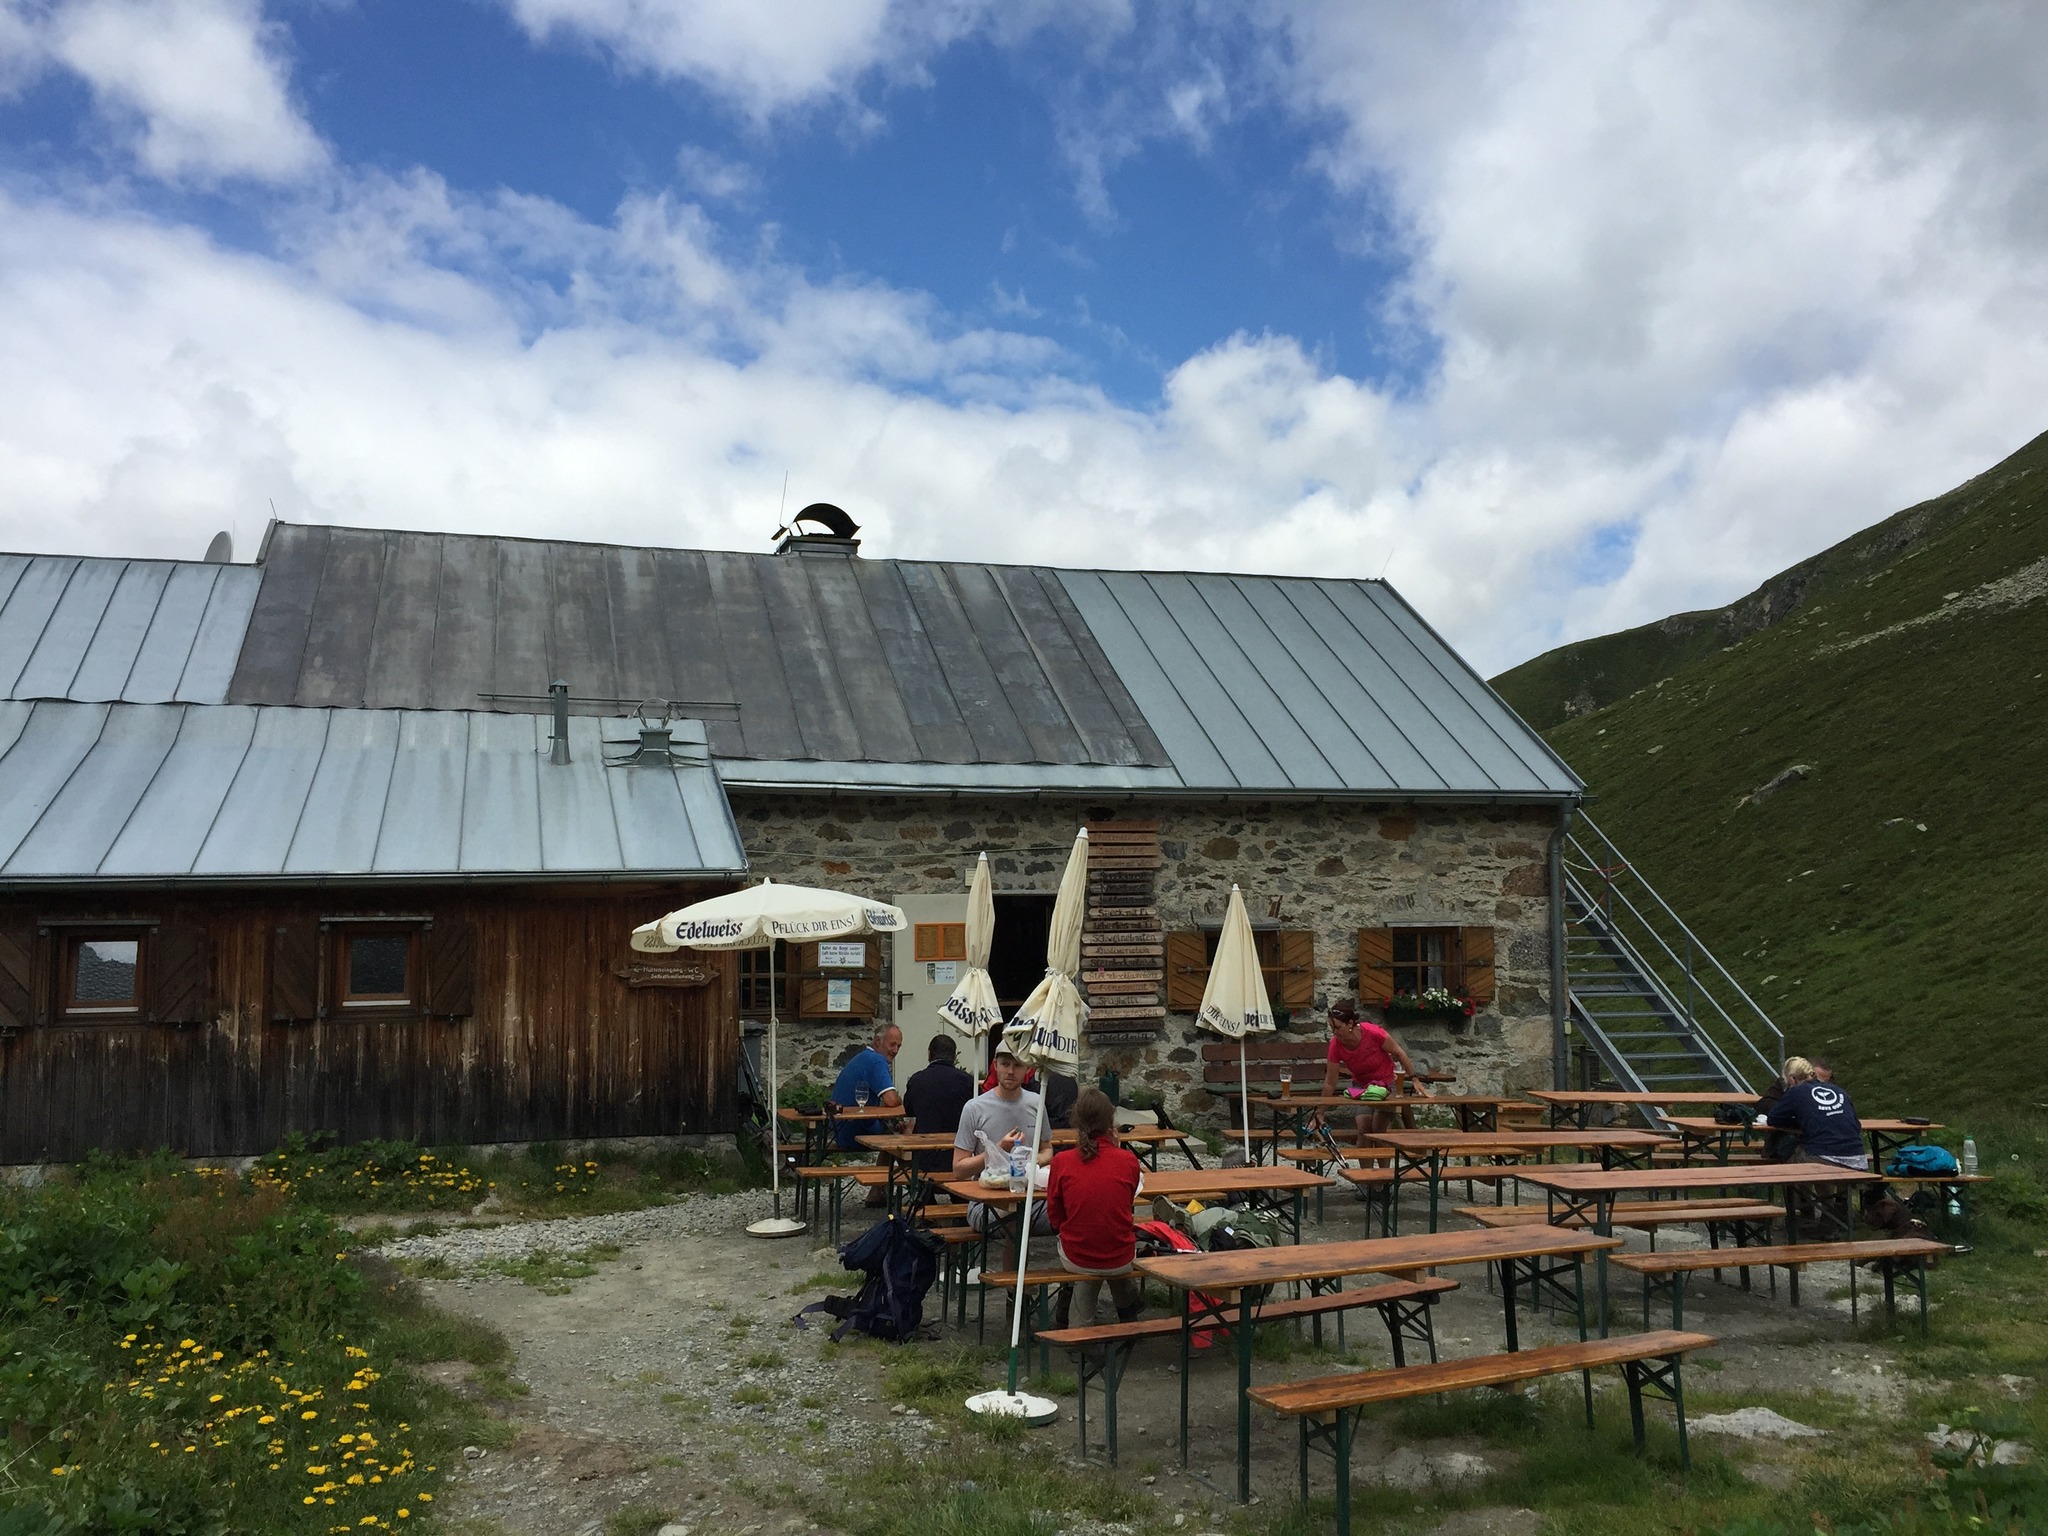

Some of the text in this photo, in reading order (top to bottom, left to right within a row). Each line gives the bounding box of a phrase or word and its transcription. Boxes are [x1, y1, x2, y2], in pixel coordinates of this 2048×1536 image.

[676, 919, 743, 940] Edelweiss
[812, 920, 828, 933] DIR
[830, 914, 856, 931] EINS!
[1057, 1035, 1078, 1055] DIR
